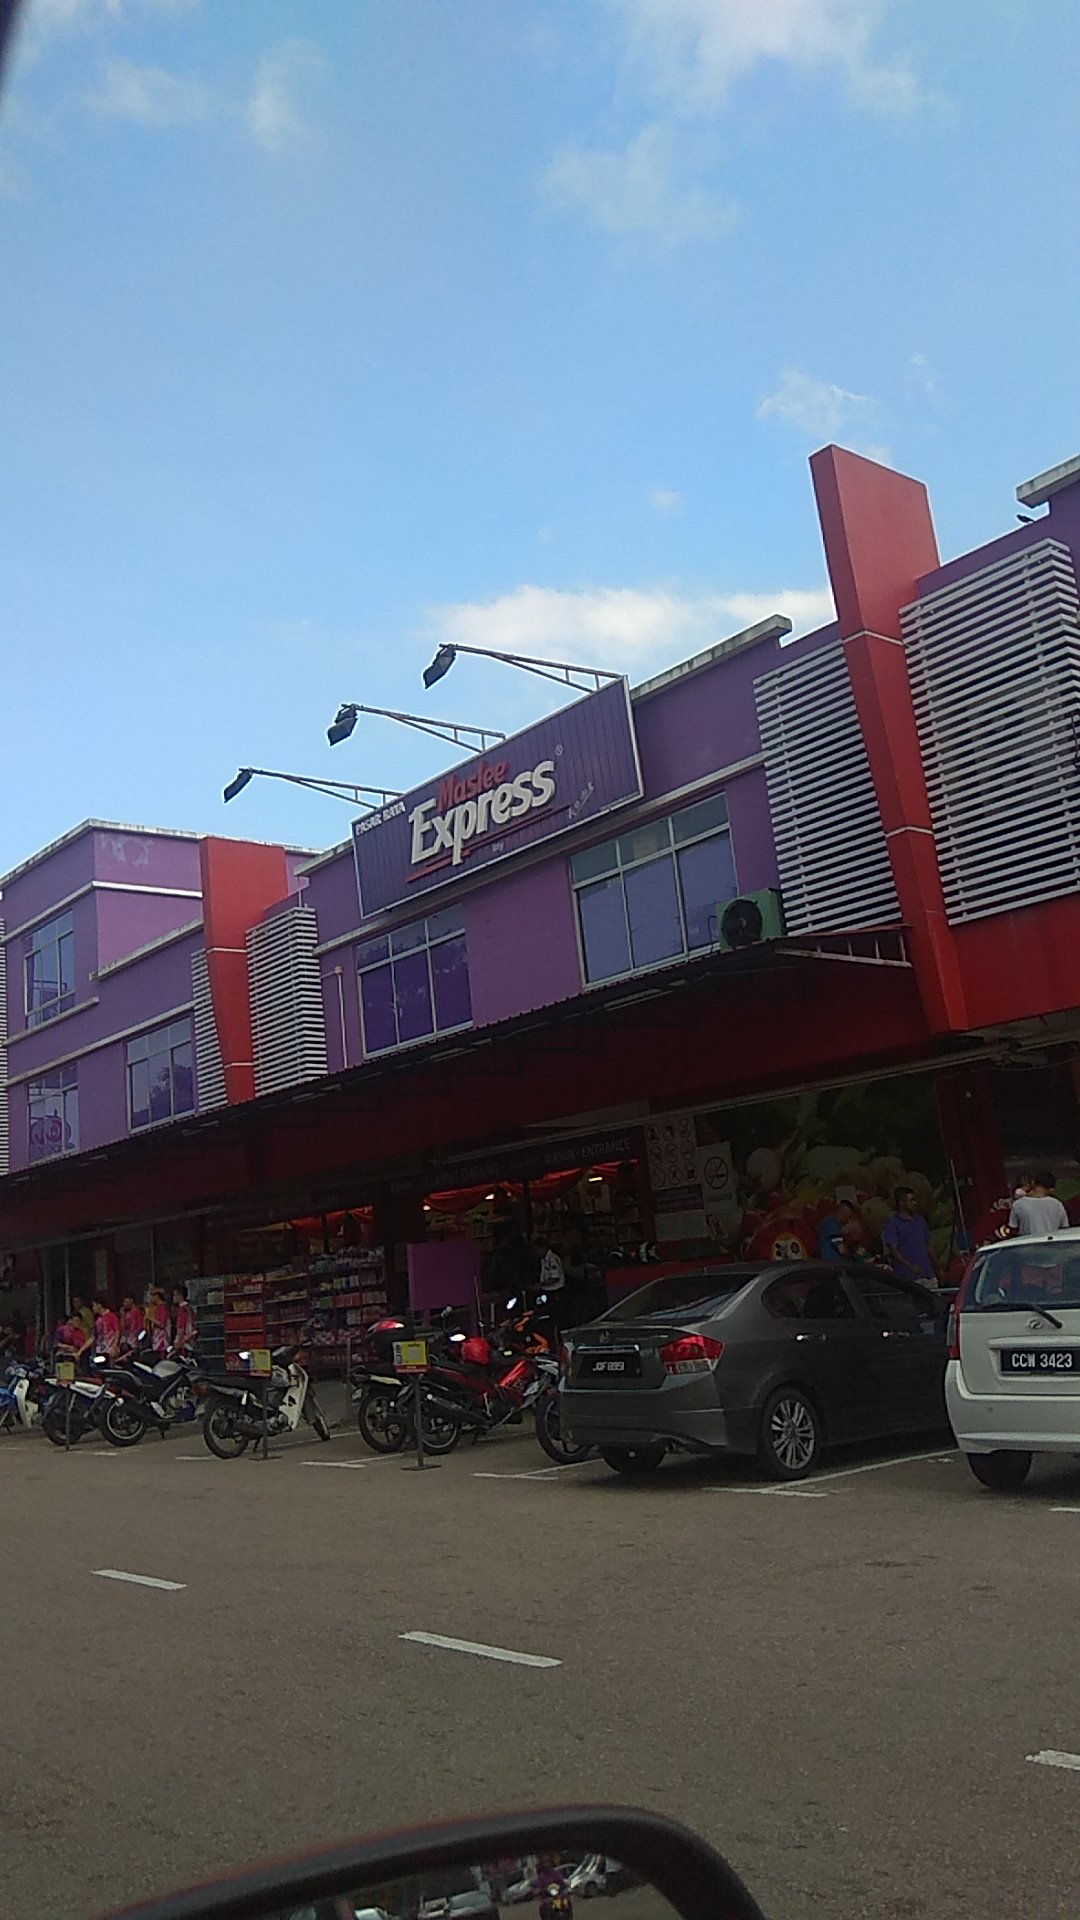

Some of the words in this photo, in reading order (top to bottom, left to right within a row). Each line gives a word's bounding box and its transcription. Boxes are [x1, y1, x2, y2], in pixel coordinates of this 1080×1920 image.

[437, 760, 507, 813] Maslee
[355, 813, 382, 836] PASAR
[408, 760, 556, 866] Express
[1011, 1353, 1036, 1368] CCW
[1039, 1353, 1073, 1368] 3423
